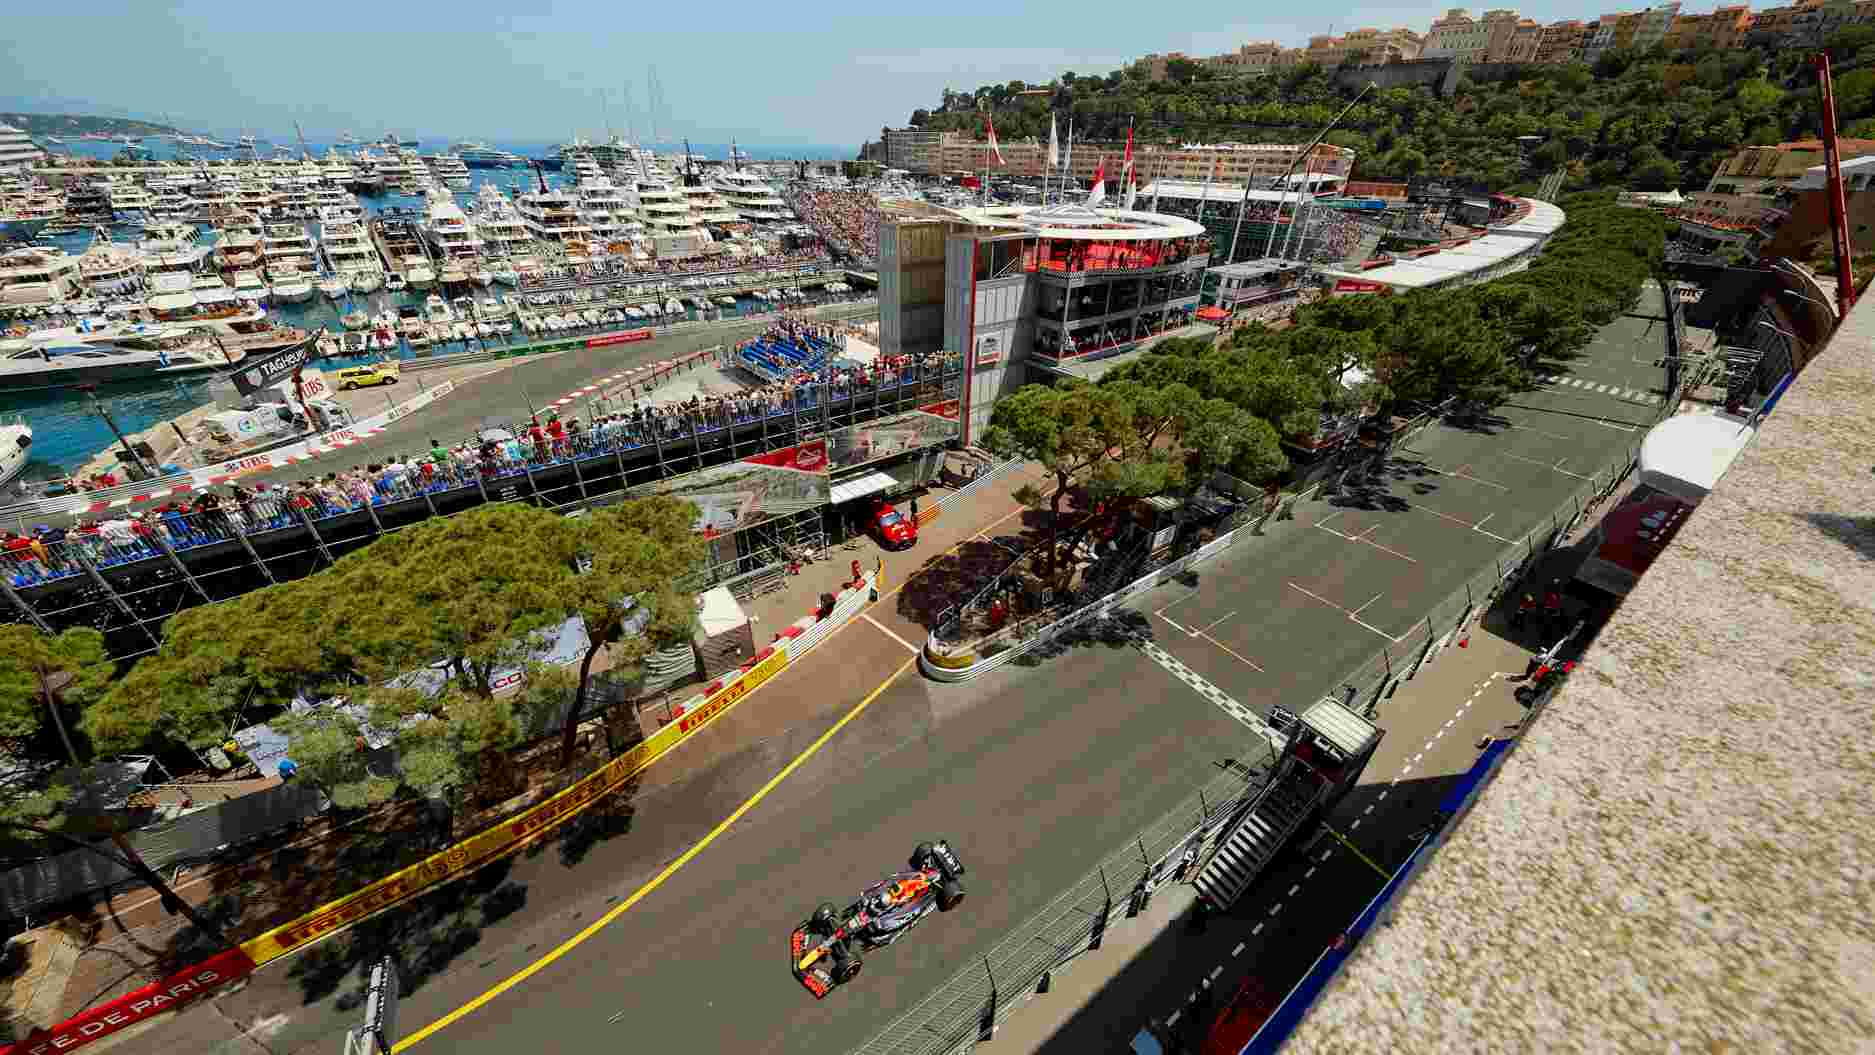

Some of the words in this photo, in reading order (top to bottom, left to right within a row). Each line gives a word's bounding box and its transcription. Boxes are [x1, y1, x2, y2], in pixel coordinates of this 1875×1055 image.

[303, 377, 323, 398] UBS
[240, 454, 271, 471] UBS
[80, 1010, 129, 1037] DE
[130, 970, 219, 1014] PARIS
